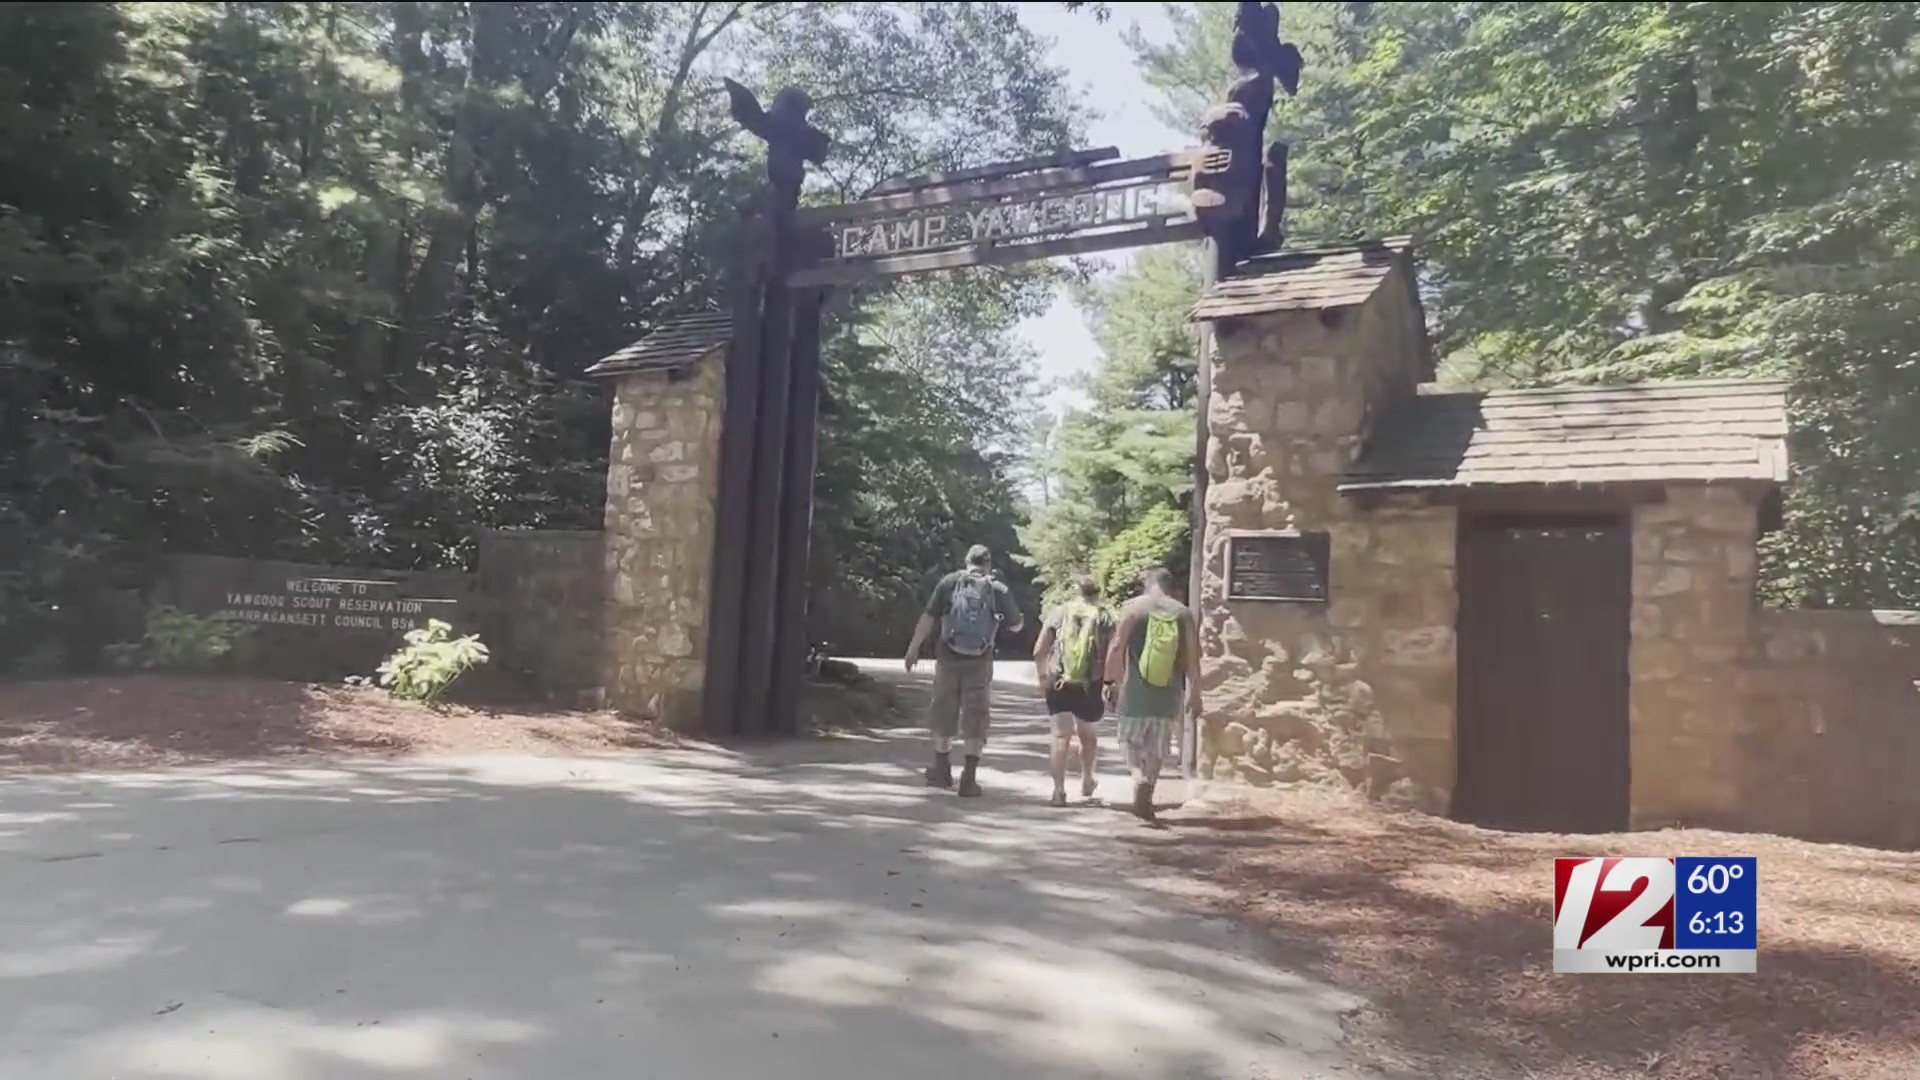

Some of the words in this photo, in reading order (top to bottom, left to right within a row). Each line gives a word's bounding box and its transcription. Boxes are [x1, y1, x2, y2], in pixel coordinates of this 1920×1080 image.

[841, 215, 946, 257] CAMP
[286, 580, 343, 594] WELCOME
[352, 583, 367, 595] TO
[292, 596, 332, 609] SCOUT
[339, 598, 423, 613] RESERVATION
[334, 614, 383, 629] COUNCIL
[391, 617, 415, 630] BSA
